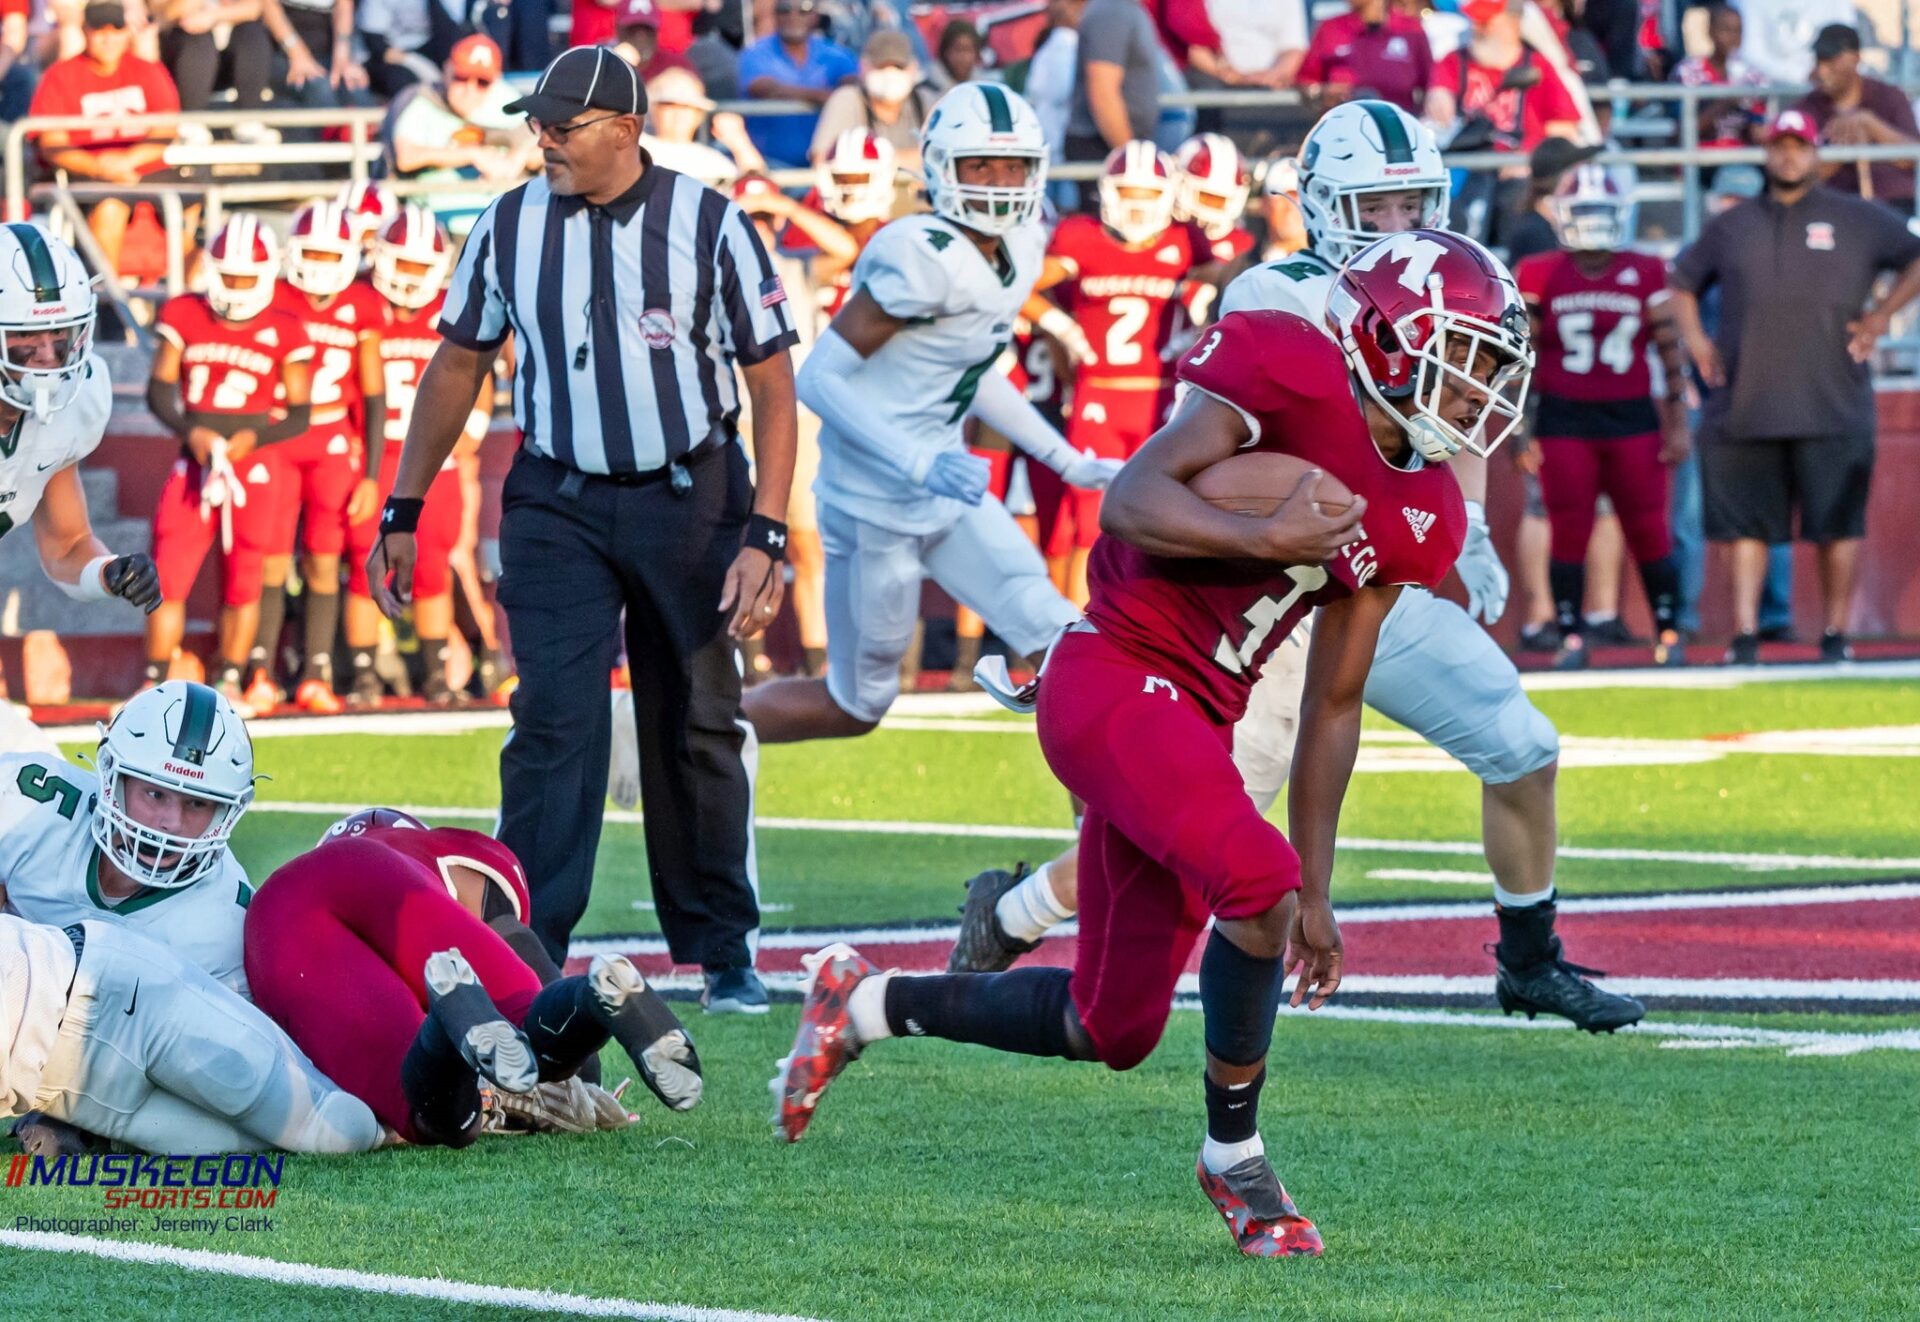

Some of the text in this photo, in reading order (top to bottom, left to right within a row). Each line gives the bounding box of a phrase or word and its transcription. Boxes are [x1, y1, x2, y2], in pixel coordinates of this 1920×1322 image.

[1106, 296, 1150, 366] 2
[1188, 330, 1222, 366] 3
[1557, 312, 1641, 375] 54
[1402, 506, 1426, 544] adidas
[16, 763, 83, 822] 5
[164, 762, 205, 780] Riddell
